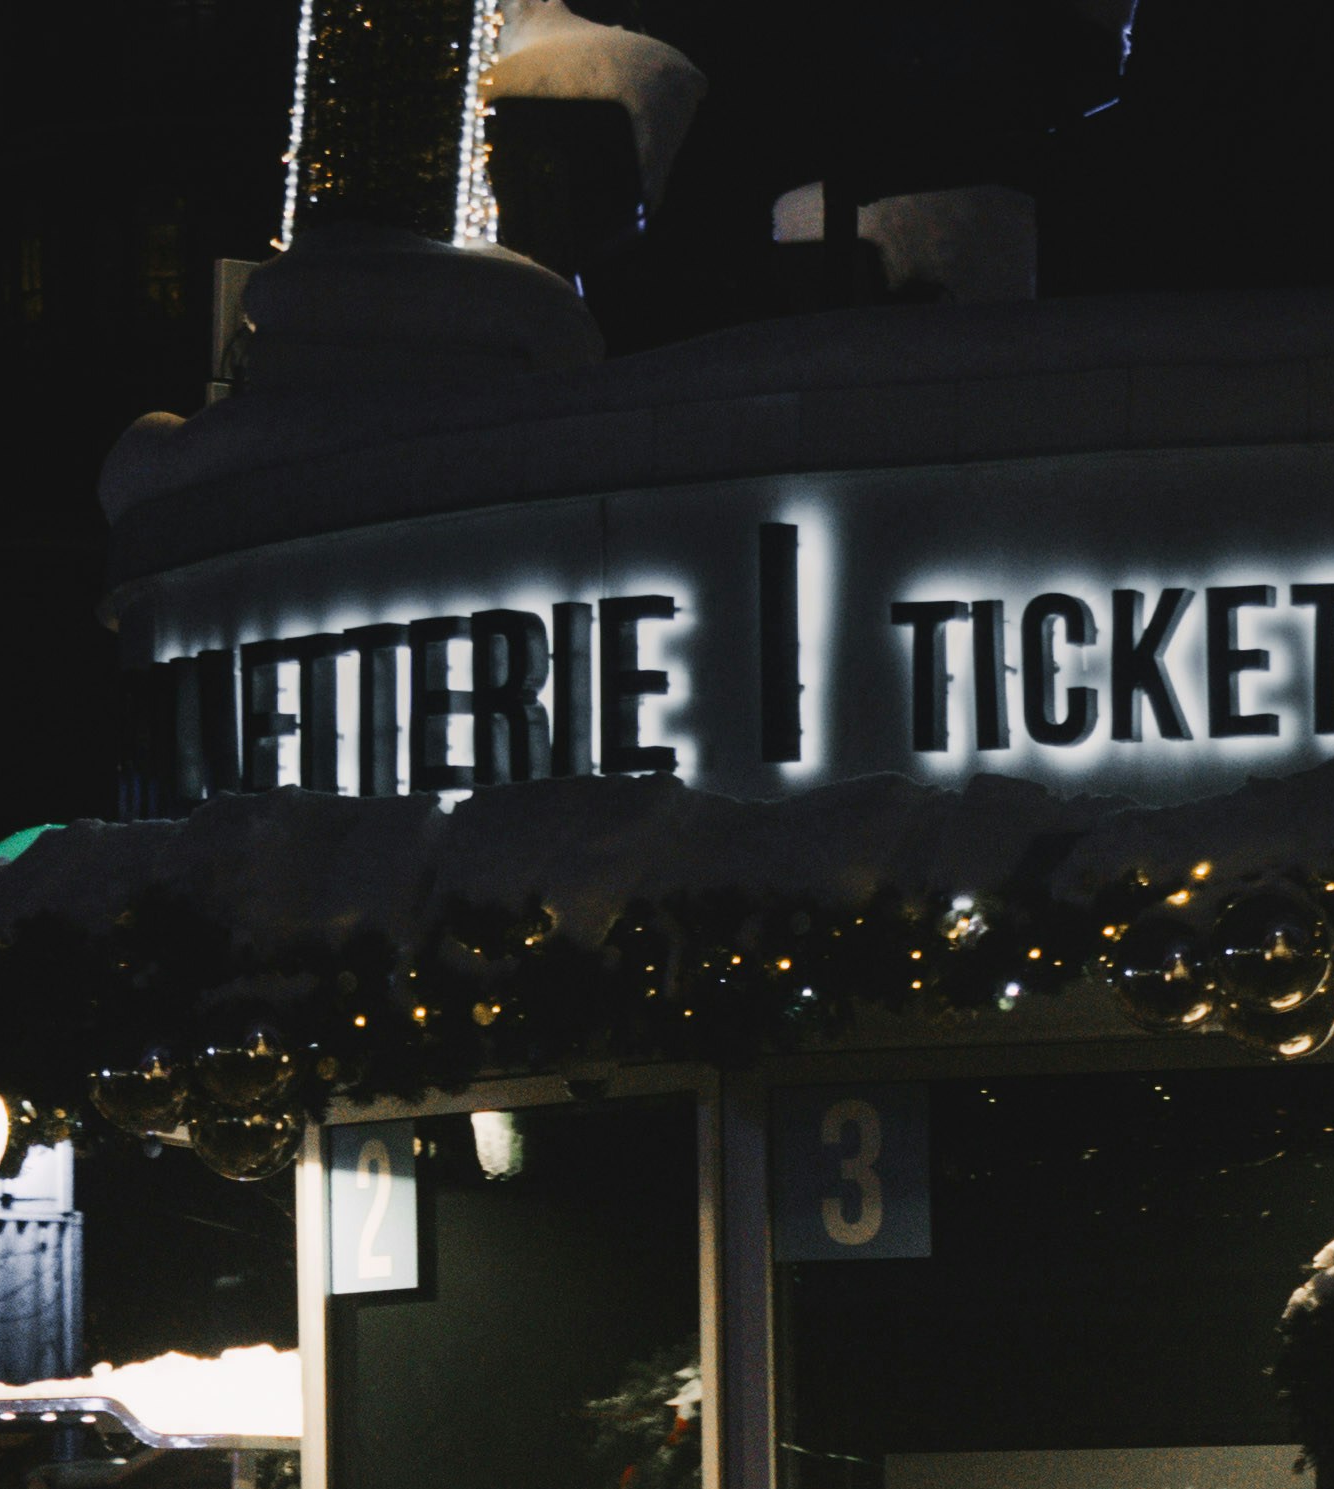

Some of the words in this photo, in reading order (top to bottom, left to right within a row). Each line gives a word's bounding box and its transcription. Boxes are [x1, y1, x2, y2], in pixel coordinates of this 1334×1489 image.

[153, 594, 677, 802] ETTERIE
[356, 1137, 393, 1279] 2
[820, 1098, 884, 1247] 3
